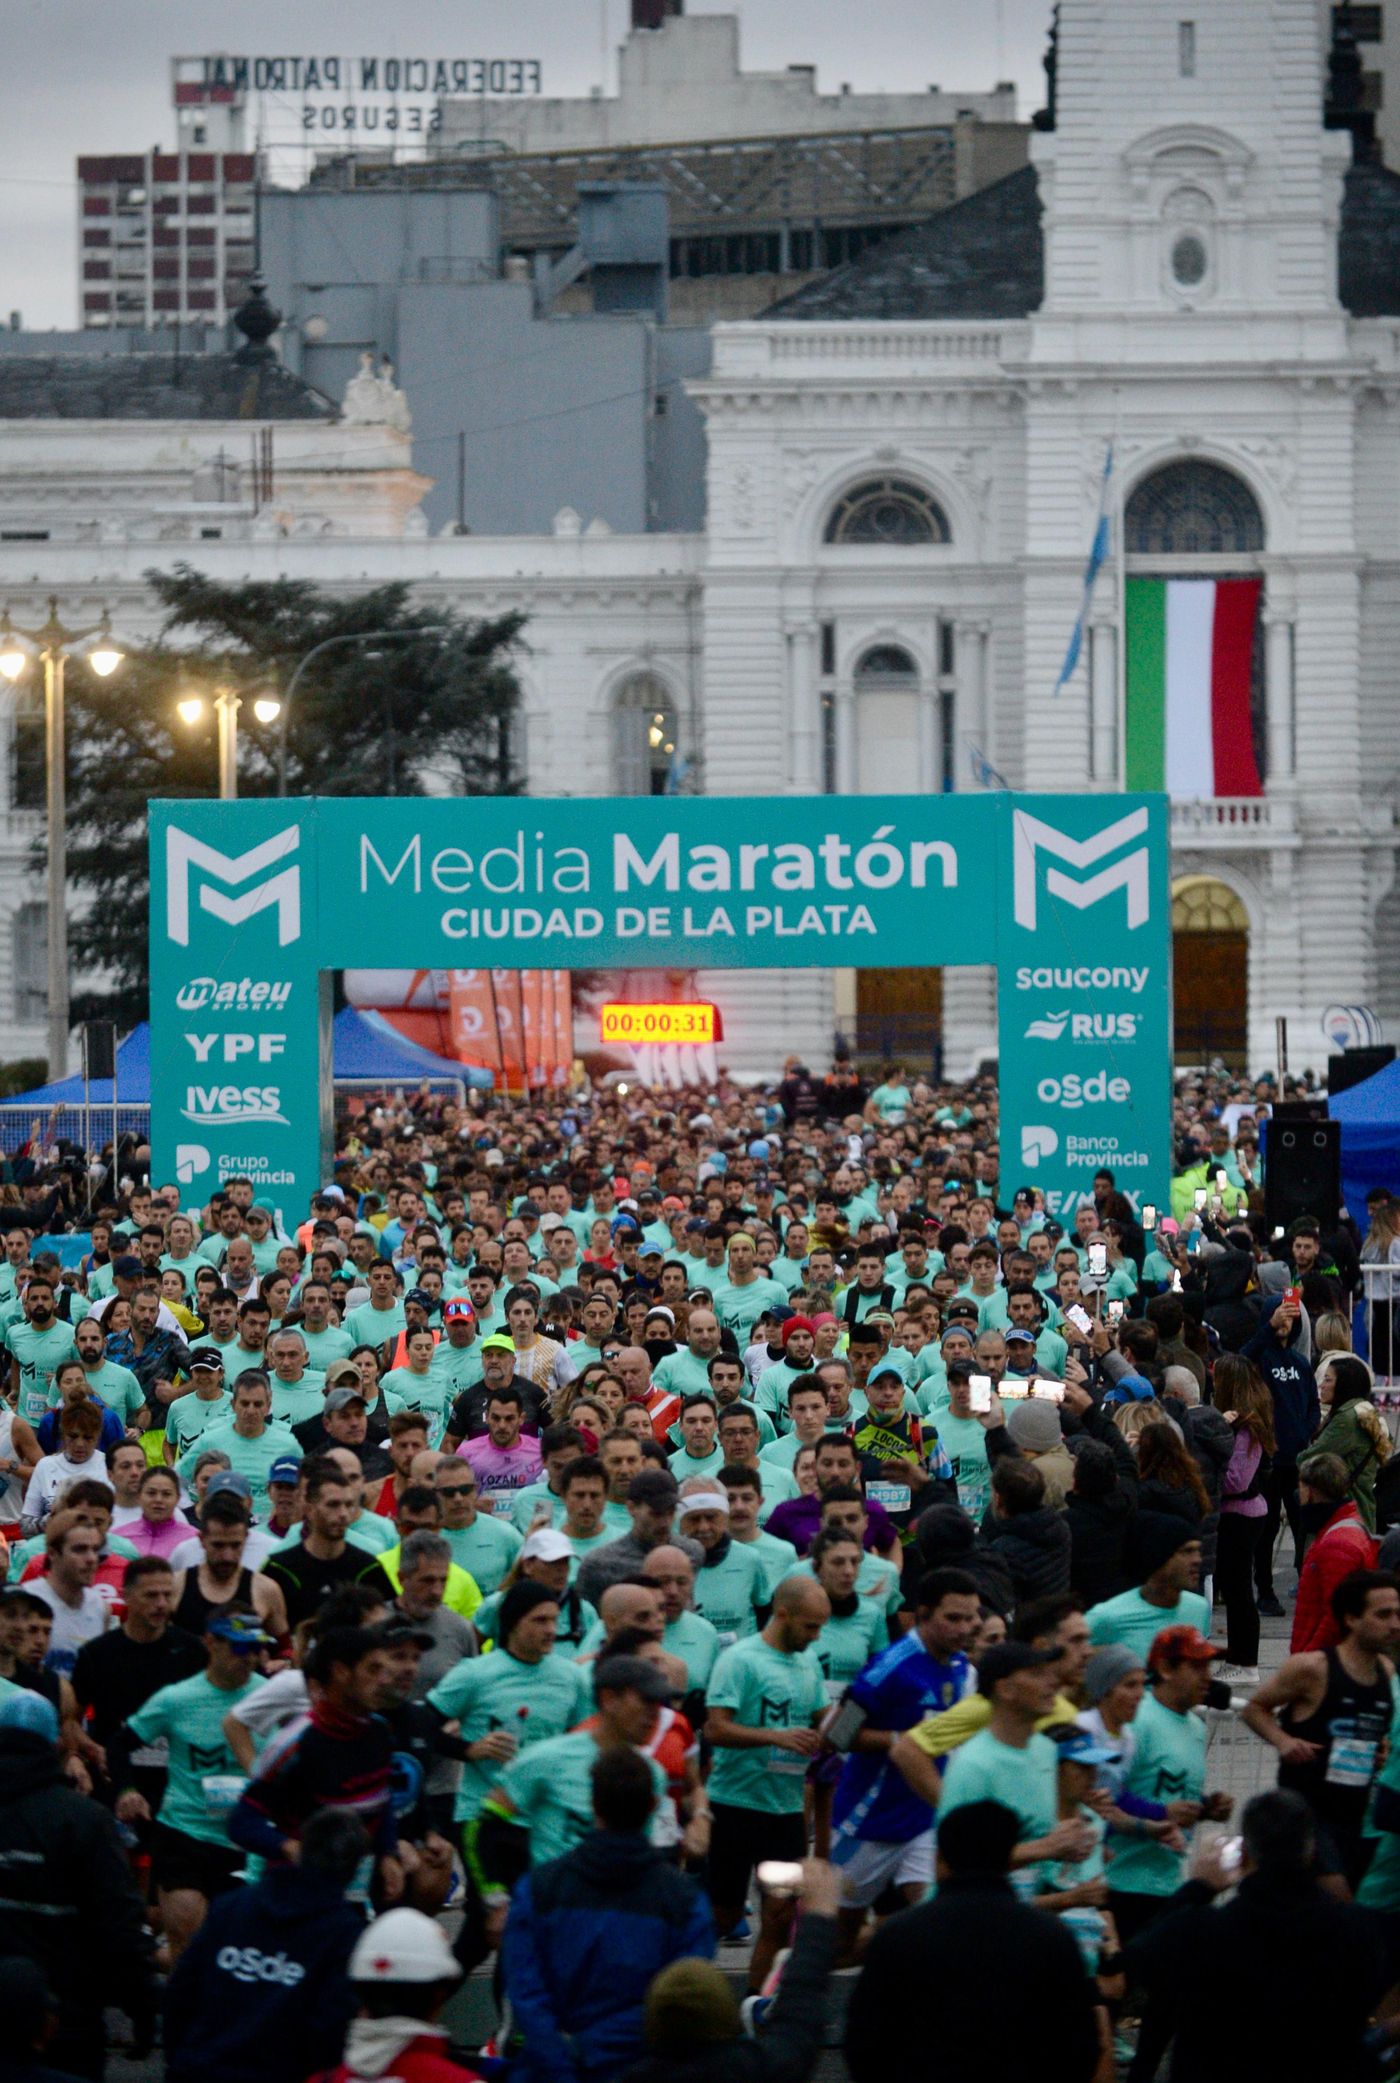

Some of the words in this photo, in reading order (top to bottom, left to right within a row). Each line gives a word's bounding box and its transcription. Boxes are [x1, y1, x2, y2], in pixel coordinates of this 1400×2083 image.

[360, 830, 591, 894] Media
[612, 825, 959, 893] Maratón
[440, 906, 605, 940] CIUDAD
[616, 906, 673, 937] DE
[683, 906, 736, 937] LA
[747, 904, 878, 936] PLATA
[176, 976, 293, 1010] mateu
[1015, 966, 1150, 994] saucony
[605, 1013, 710, 1033] 00:00:31
[184, 1033, 287, 1063] YPF
[1037, 1069, 1132, 1109] osde
[1066, 1135, 1119, 1150] Banco
[218, 1154, 269, 1171] Grupo
[1066, 1151, 1149, 1167] Provincia
[1042, 1190, 1142, 1216] E/MX
[480, 1474, 527, 1485] LOZANO
[870, 1490, 907, 1501] M987
[216, 1945, 306, 1987] osde
